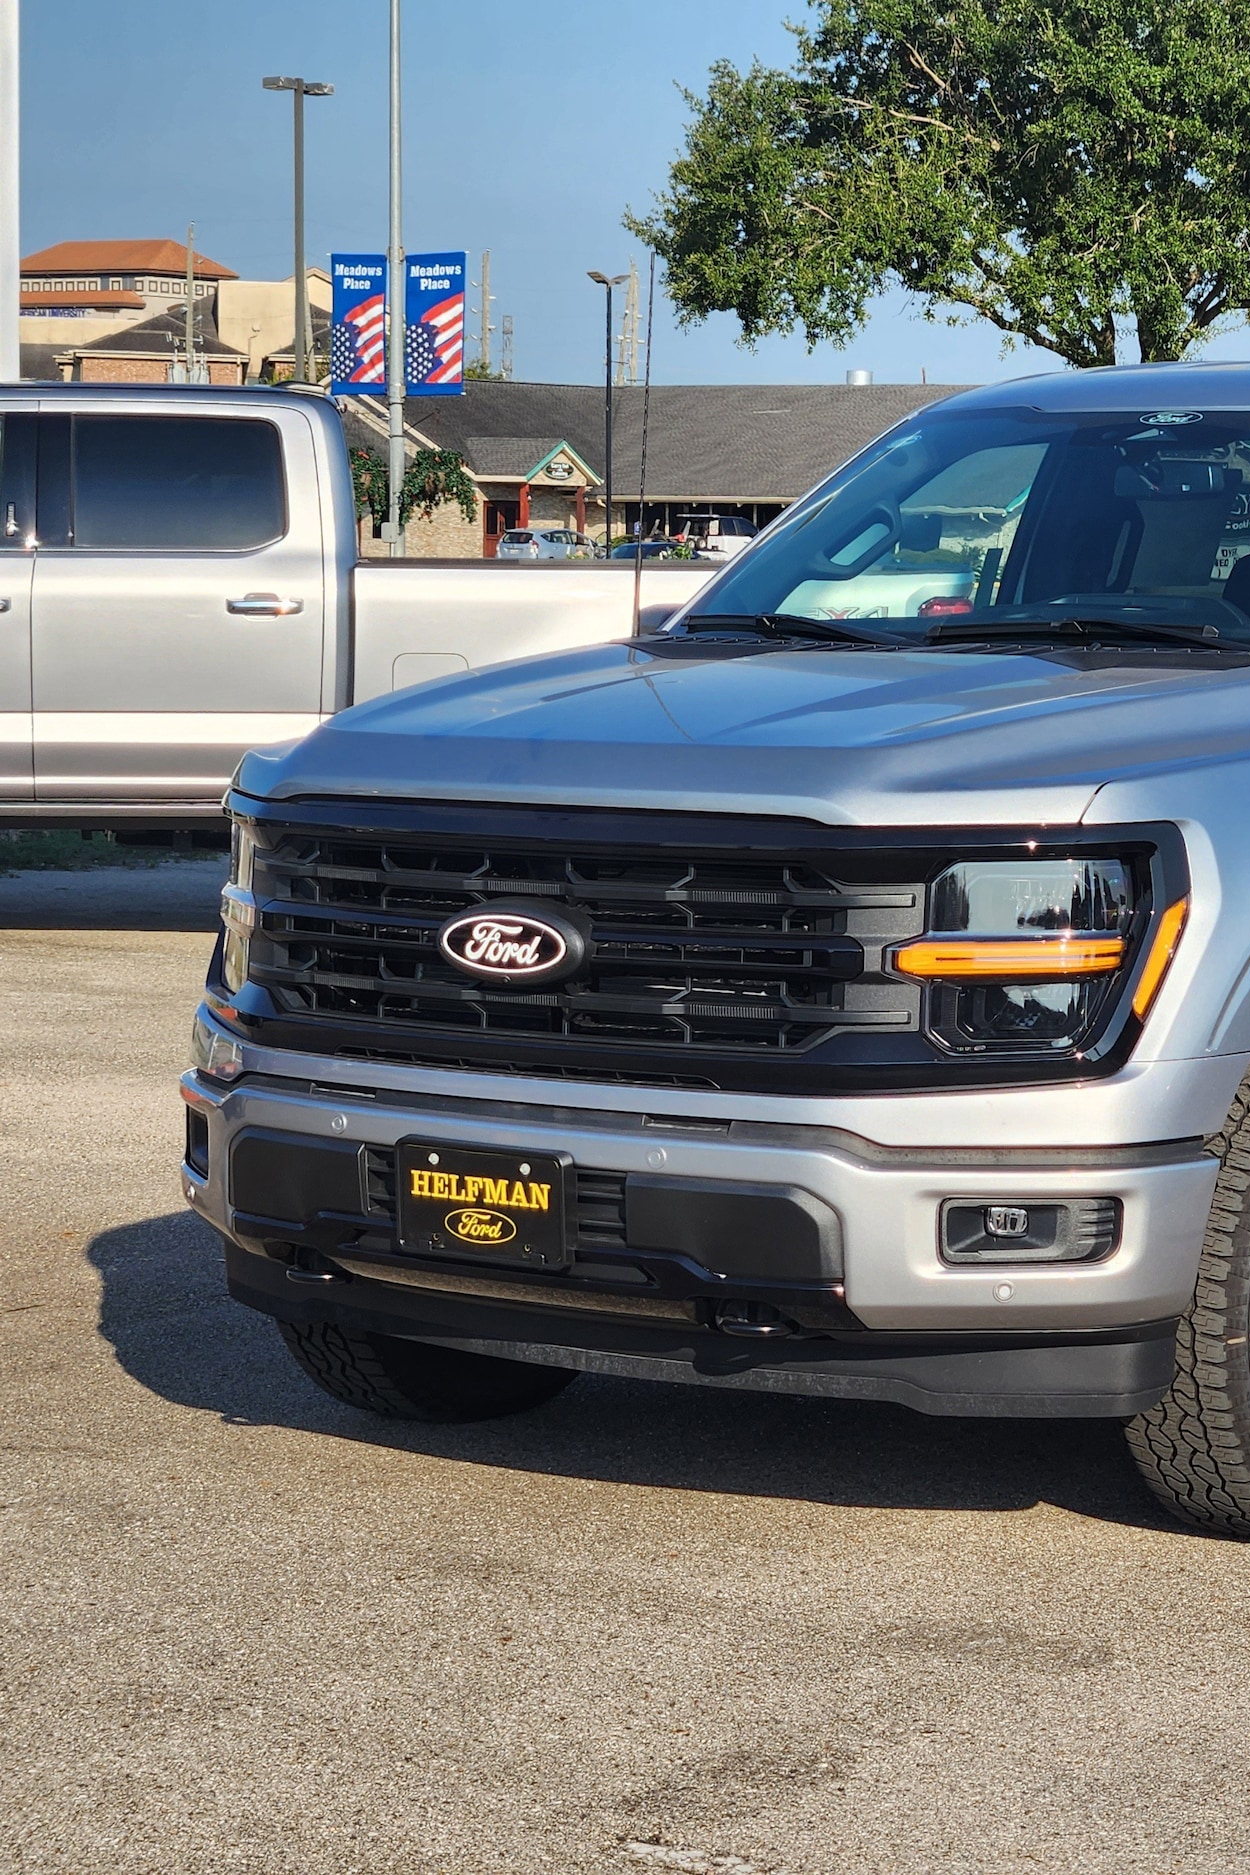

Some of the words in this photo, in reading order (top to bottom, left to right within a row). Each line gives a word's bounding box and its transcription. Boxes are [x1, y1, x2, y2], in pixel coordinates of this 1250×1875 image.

[334, 264, 383, 277] Meadows
[410, 264, 462, 278] Meadows
[343, 278, 371, 290] Place
[420, 278, 450, 291] Place
[465, 921, 540, 965] Ford
[410, 1169, 552, 1211] HELFMAN
[458, 1211, 503, 1239] Ford
